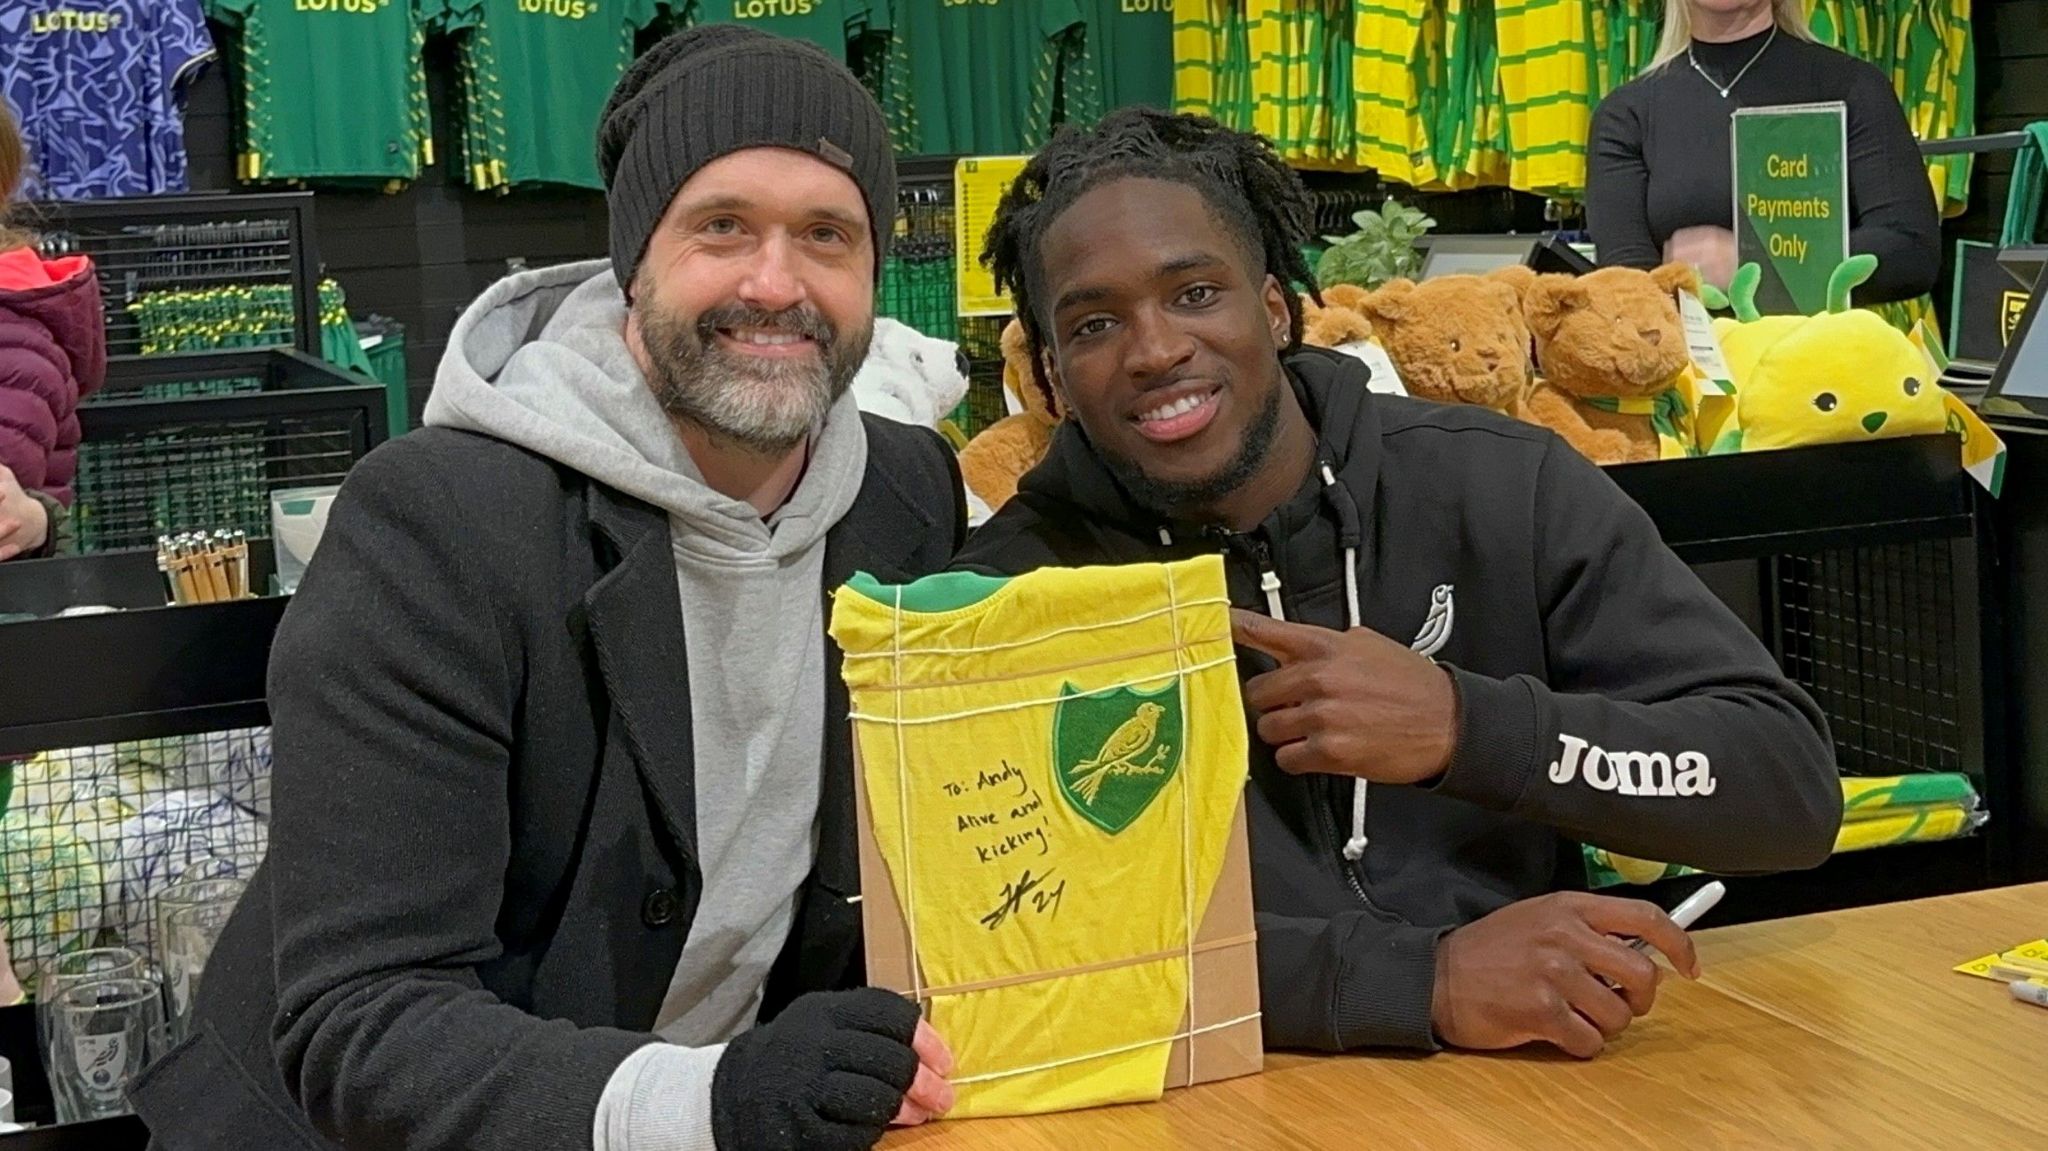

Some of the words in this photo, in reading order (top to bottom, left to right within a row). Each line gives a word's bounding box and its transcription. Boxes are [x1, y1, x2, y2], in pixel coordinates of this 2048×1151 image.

[296, 0, 376, 13] LOTUS
[519, 0, 585, 19] LOTUS
[734, 0, 812, 18] LOTUS
[1121, 0, 1174, 12] LOTU
[32, 10, 109, 33] LOTUS
[1767, 153, 1808, 178] Card
[1747, 193, 1830, 224] Payments
[1769, 233, 1807, 264] Only
[1548, 732, 1716, 797] Joma
[977, 759, 1028, 797] Andy
[956, 813, 999, 833] Alive
[1010, 789, 1044, 819] and
